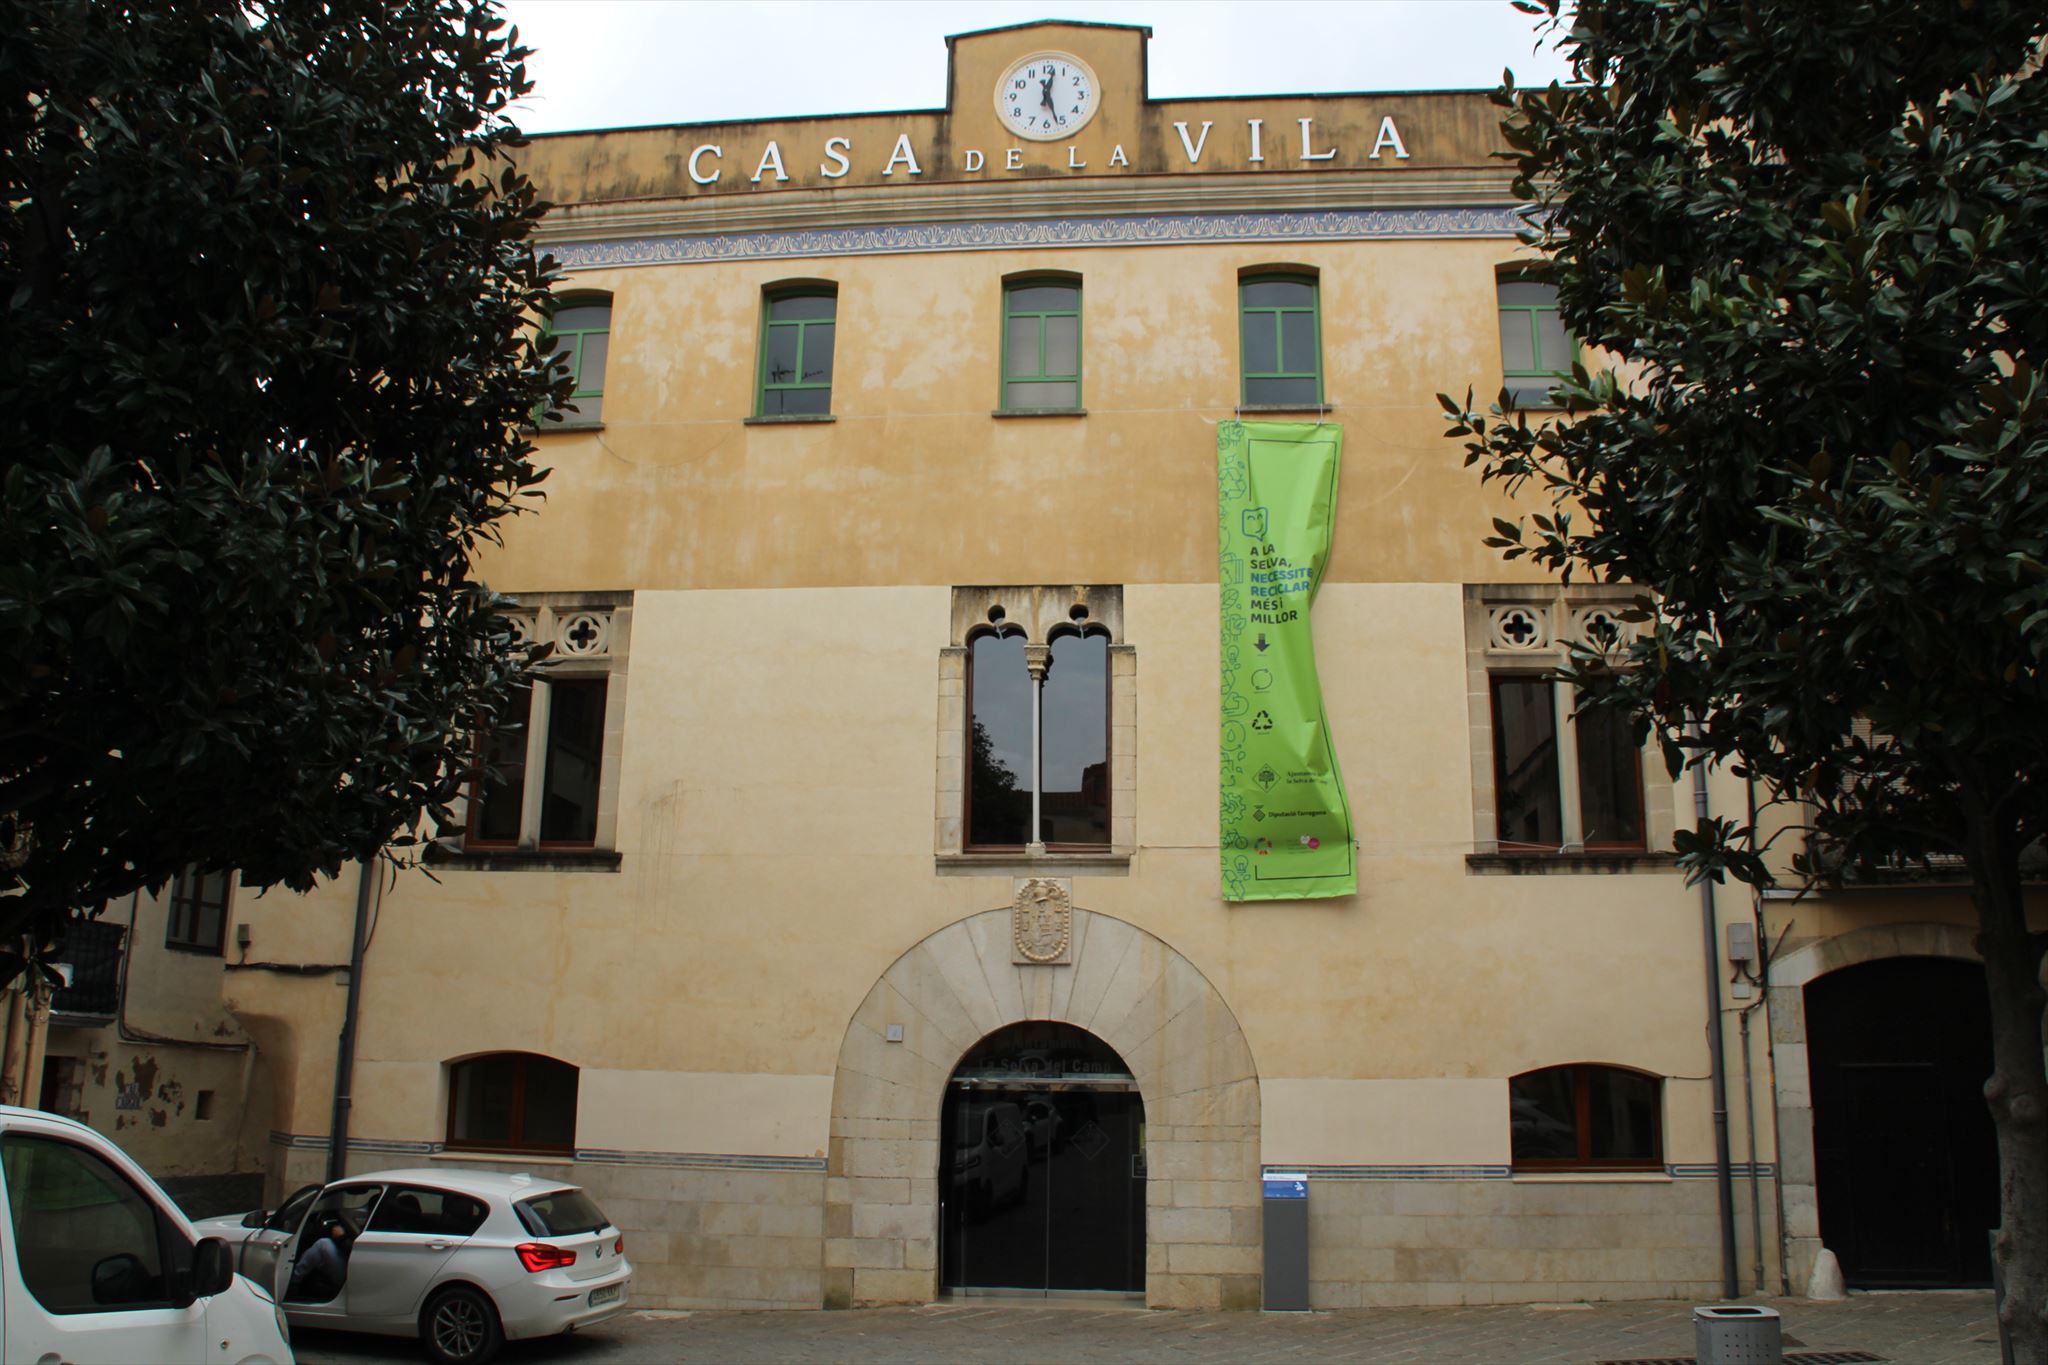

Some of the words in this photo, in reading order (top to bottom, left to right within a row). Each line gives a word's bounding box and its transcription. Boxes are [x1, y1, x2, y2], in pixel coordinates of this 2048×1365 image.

[1028, 69, 1035, 79] 11
[1043, 65, 1055, 75] 12
[1015, 80, 1026, 89] 10
[1072, 77, 1080, 86] 2
[1009, 93, 1017, 102] 9
[1077, 91, 1084, 100] 3
[1013, 107, 1021, 117] 8
[1071, 105, 1079, 114] 4
[1028, 116, 1036, 126] 7
[1043, 120, 1051, 129] 6
[1059, 115, 1066, 125] 5
[688, 134, 922, 184] CASA
[965, 148, 1024, 172] DE
[1068, 144, 1129, 168] LA
[1173, 116, 1410, 164] VILA
[1250, 546, 1259, 556] A
[1262, 544, 1275, 556] LA
[1250, 557, 1292, 570] SELVA,
[1250, 568, 1313, 583] NECESSITE
[1250, 581, 1310, 597] RECICLAR
[1250, 597, 1279, 611] MÉS
[1250, 610, 1298, 624] MILLOR
